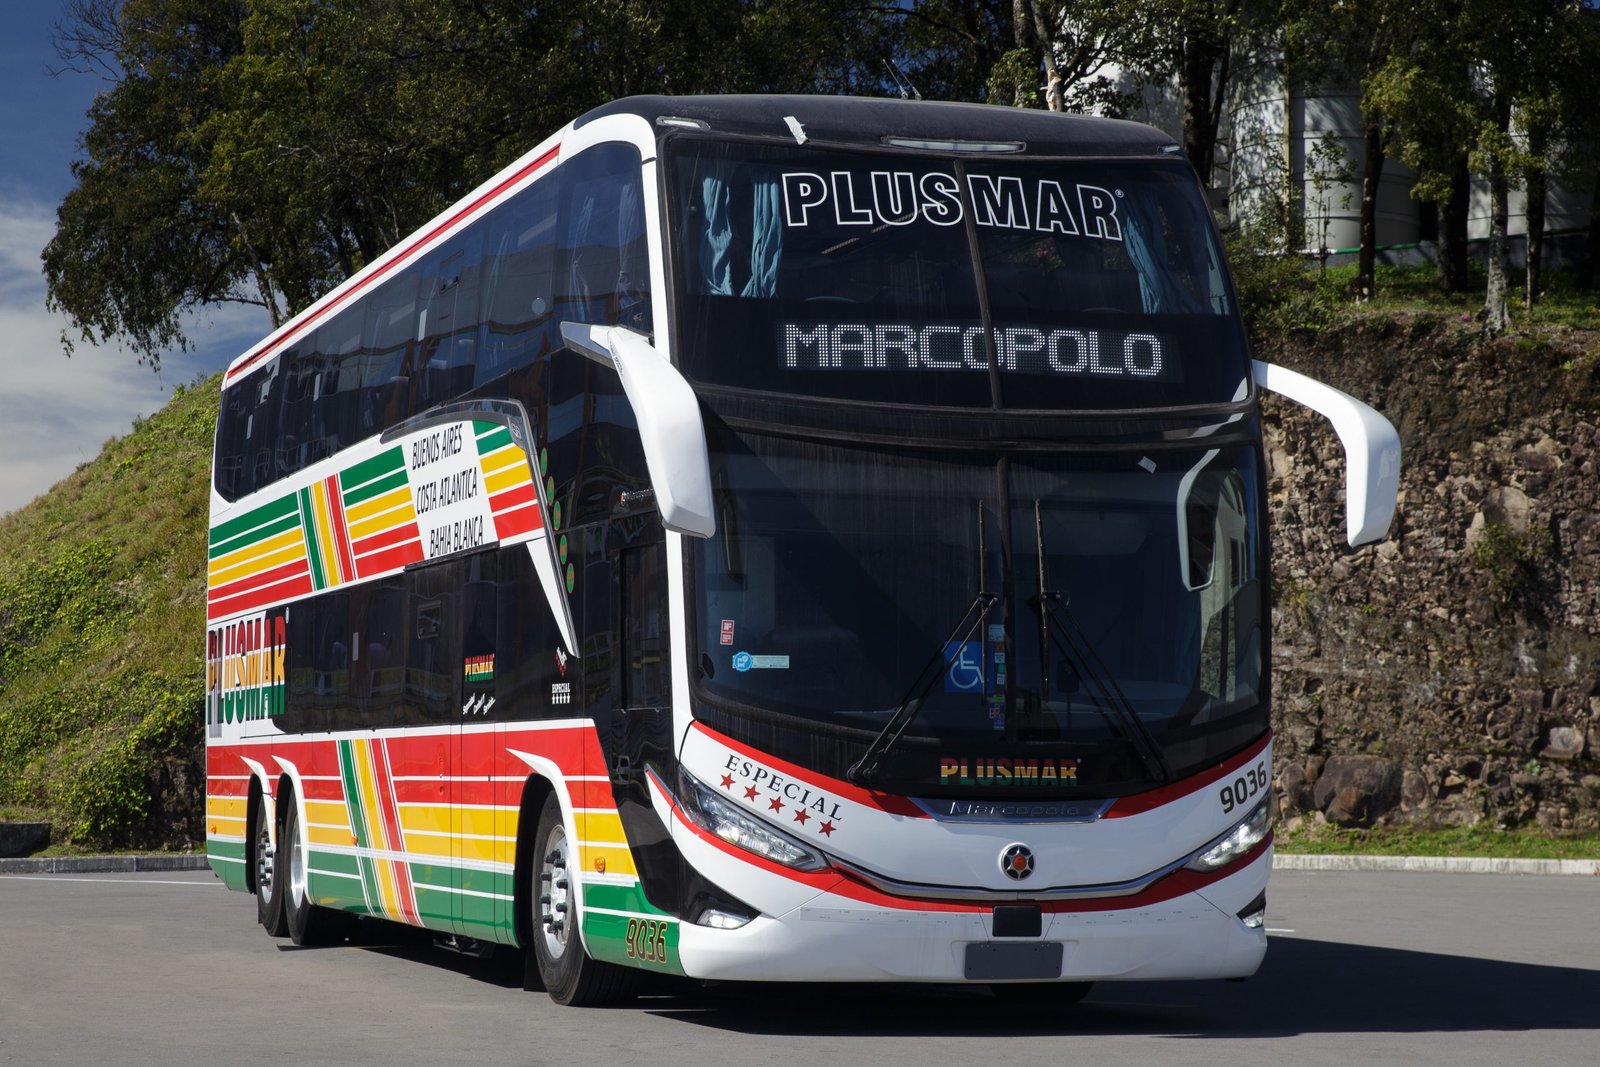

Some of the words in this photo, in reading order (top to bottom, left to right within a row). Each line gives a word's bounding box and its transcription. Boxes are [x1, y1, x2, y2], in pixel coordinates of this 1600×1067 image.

[782, 171, 1123, 241] PLUSMAR
[786, 323, 1162, 376] MARCOPOLO
[412, 432, 440, 470] BUENOS
[441, 423, 463, 459] AIRES
[416, 481, 437, 515] COSTA
[438, 467, 478, 507] ATLANTICA
[429, 524, 451, 558] BAHIA
[453, 515, 484, 551] BLANCA
[207, 615, 287, 726] PLUSMAR
[724, 753, 843, 821] ESPECIAL
[940, 757, 1078, 787] PLUSMAR
[1219, 760, 1267, 814] 9036
[949, 801, 1080, 816] Marcopolo
[625, 917, 668, 964] 9036
